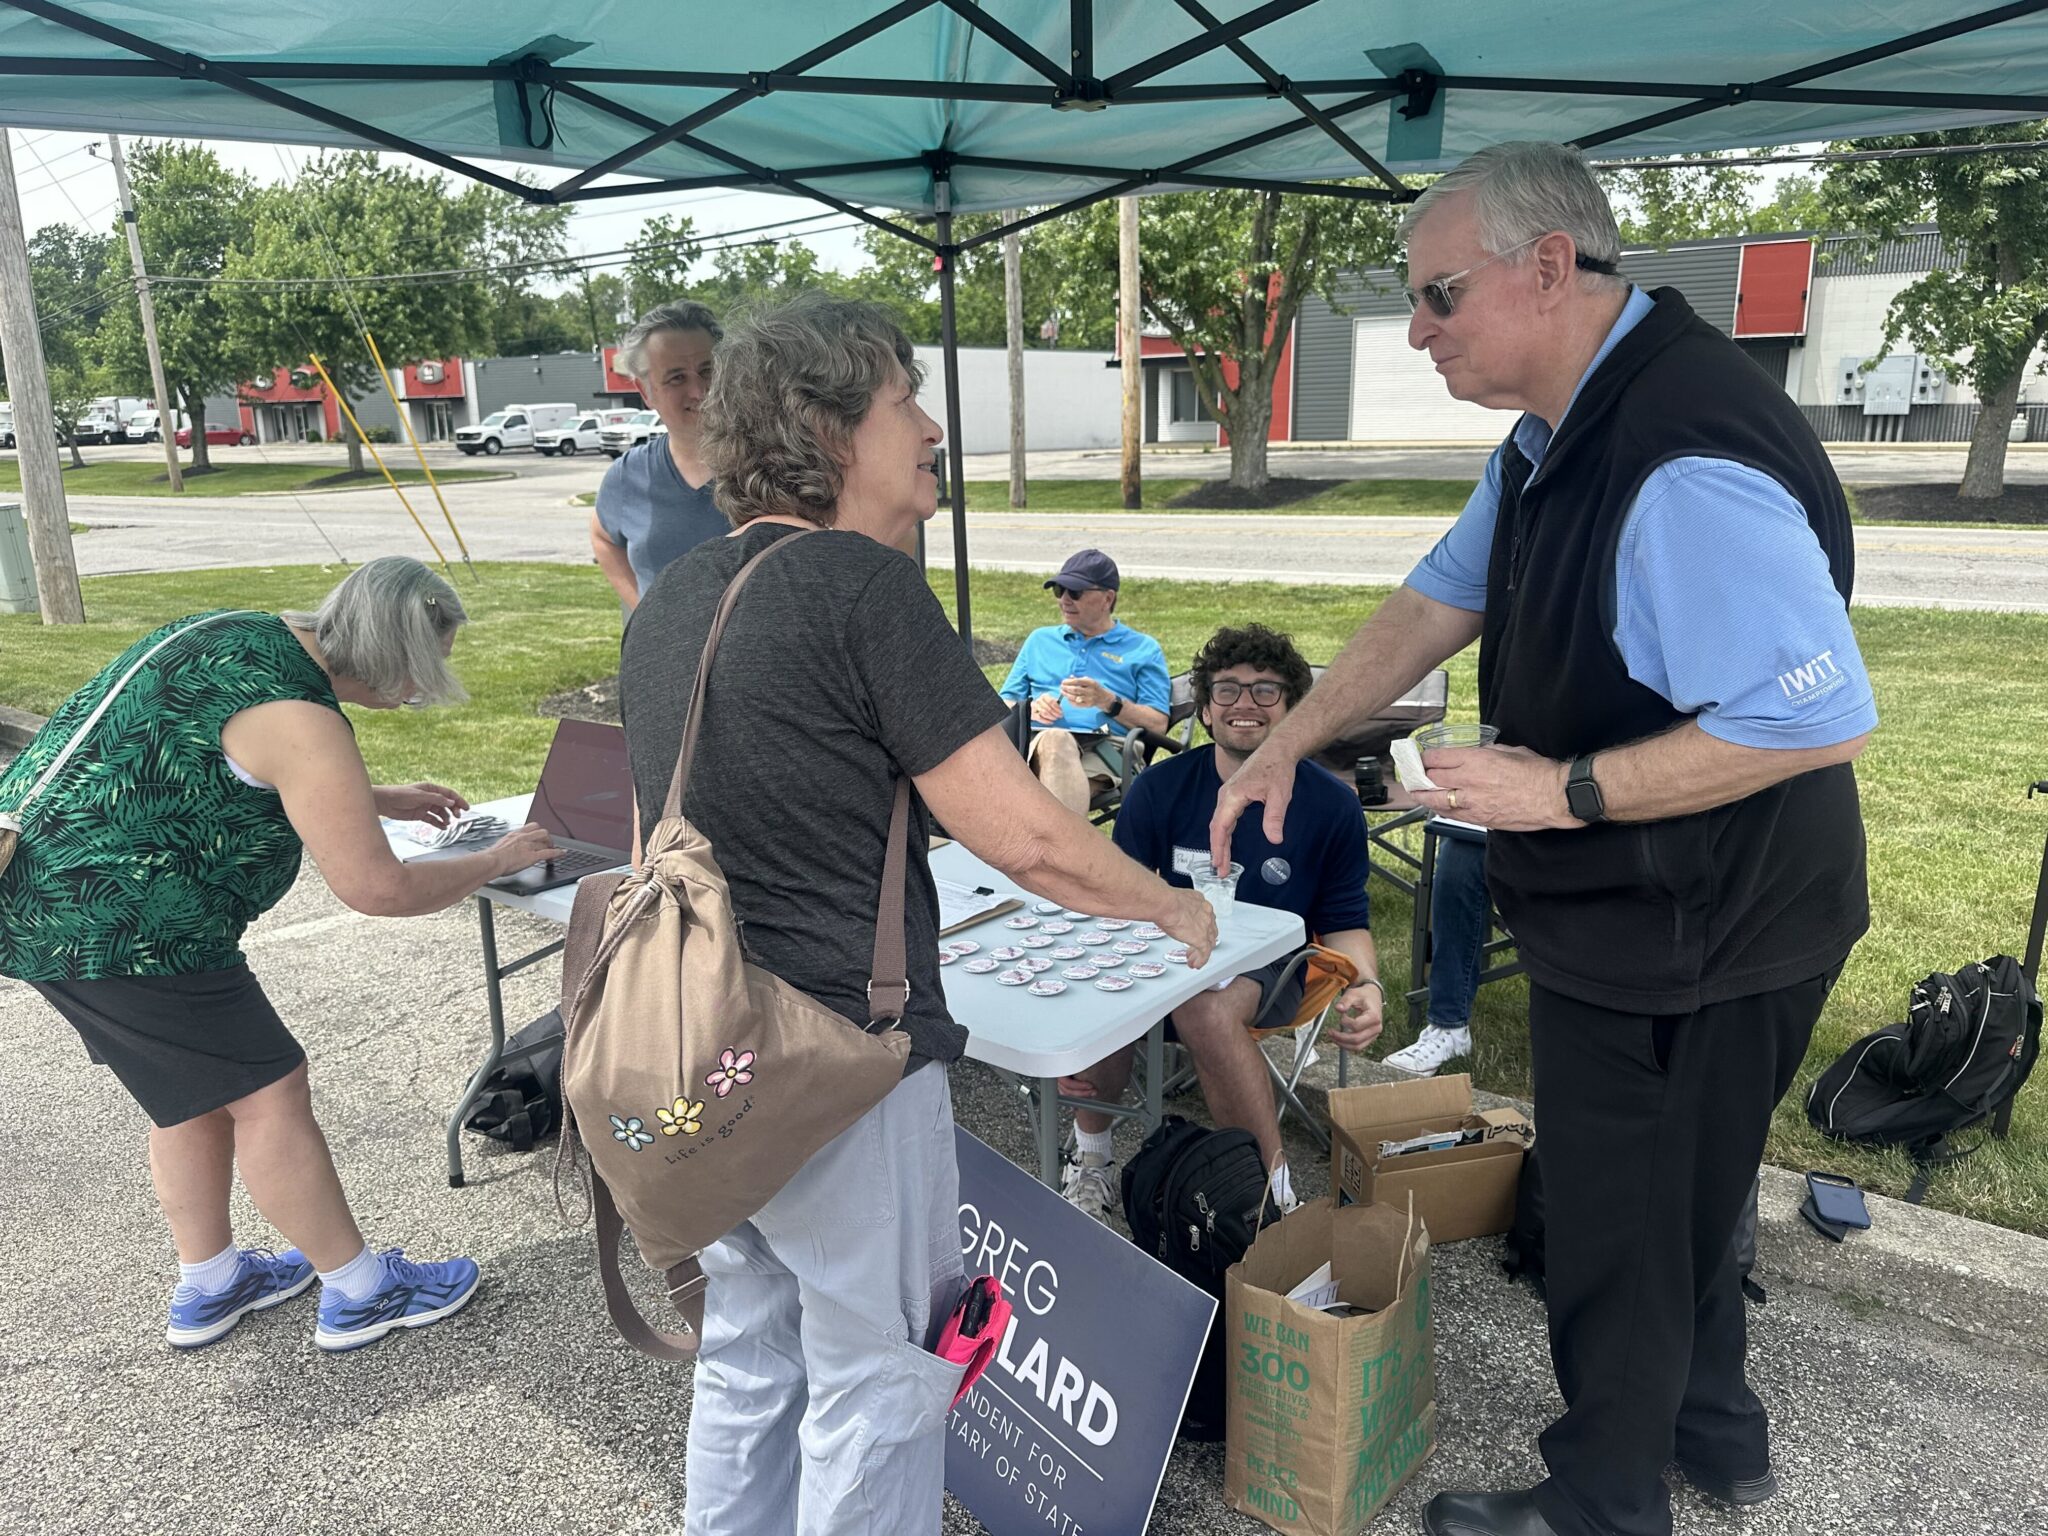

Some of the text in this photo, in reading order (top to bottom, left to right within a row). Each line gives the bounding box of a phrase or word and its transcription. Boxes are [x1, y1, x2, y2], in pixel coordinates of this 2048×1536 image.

[665, 1148, 698, 1165] Life
[700, 1136, 714, 1147] is
[958, 1203, 1058, 1316] GREG
[1243, 1311, 1310, 1353] WE BAN
[992, 1314, 1118, 1446] LARD
[1240, 1341, 1310, 1392] 300
[945, 1409, 992, 1459] TARY
[995, 1456, 1021, 1486] OF
[960, 1385, 1067, 1490] NDENT FOR
[1247, 1453, 1298, 1489] PEACE
[1351, 1467, 1390, 1520] THE
[1246, 1483, 1298, 1521] MIND
